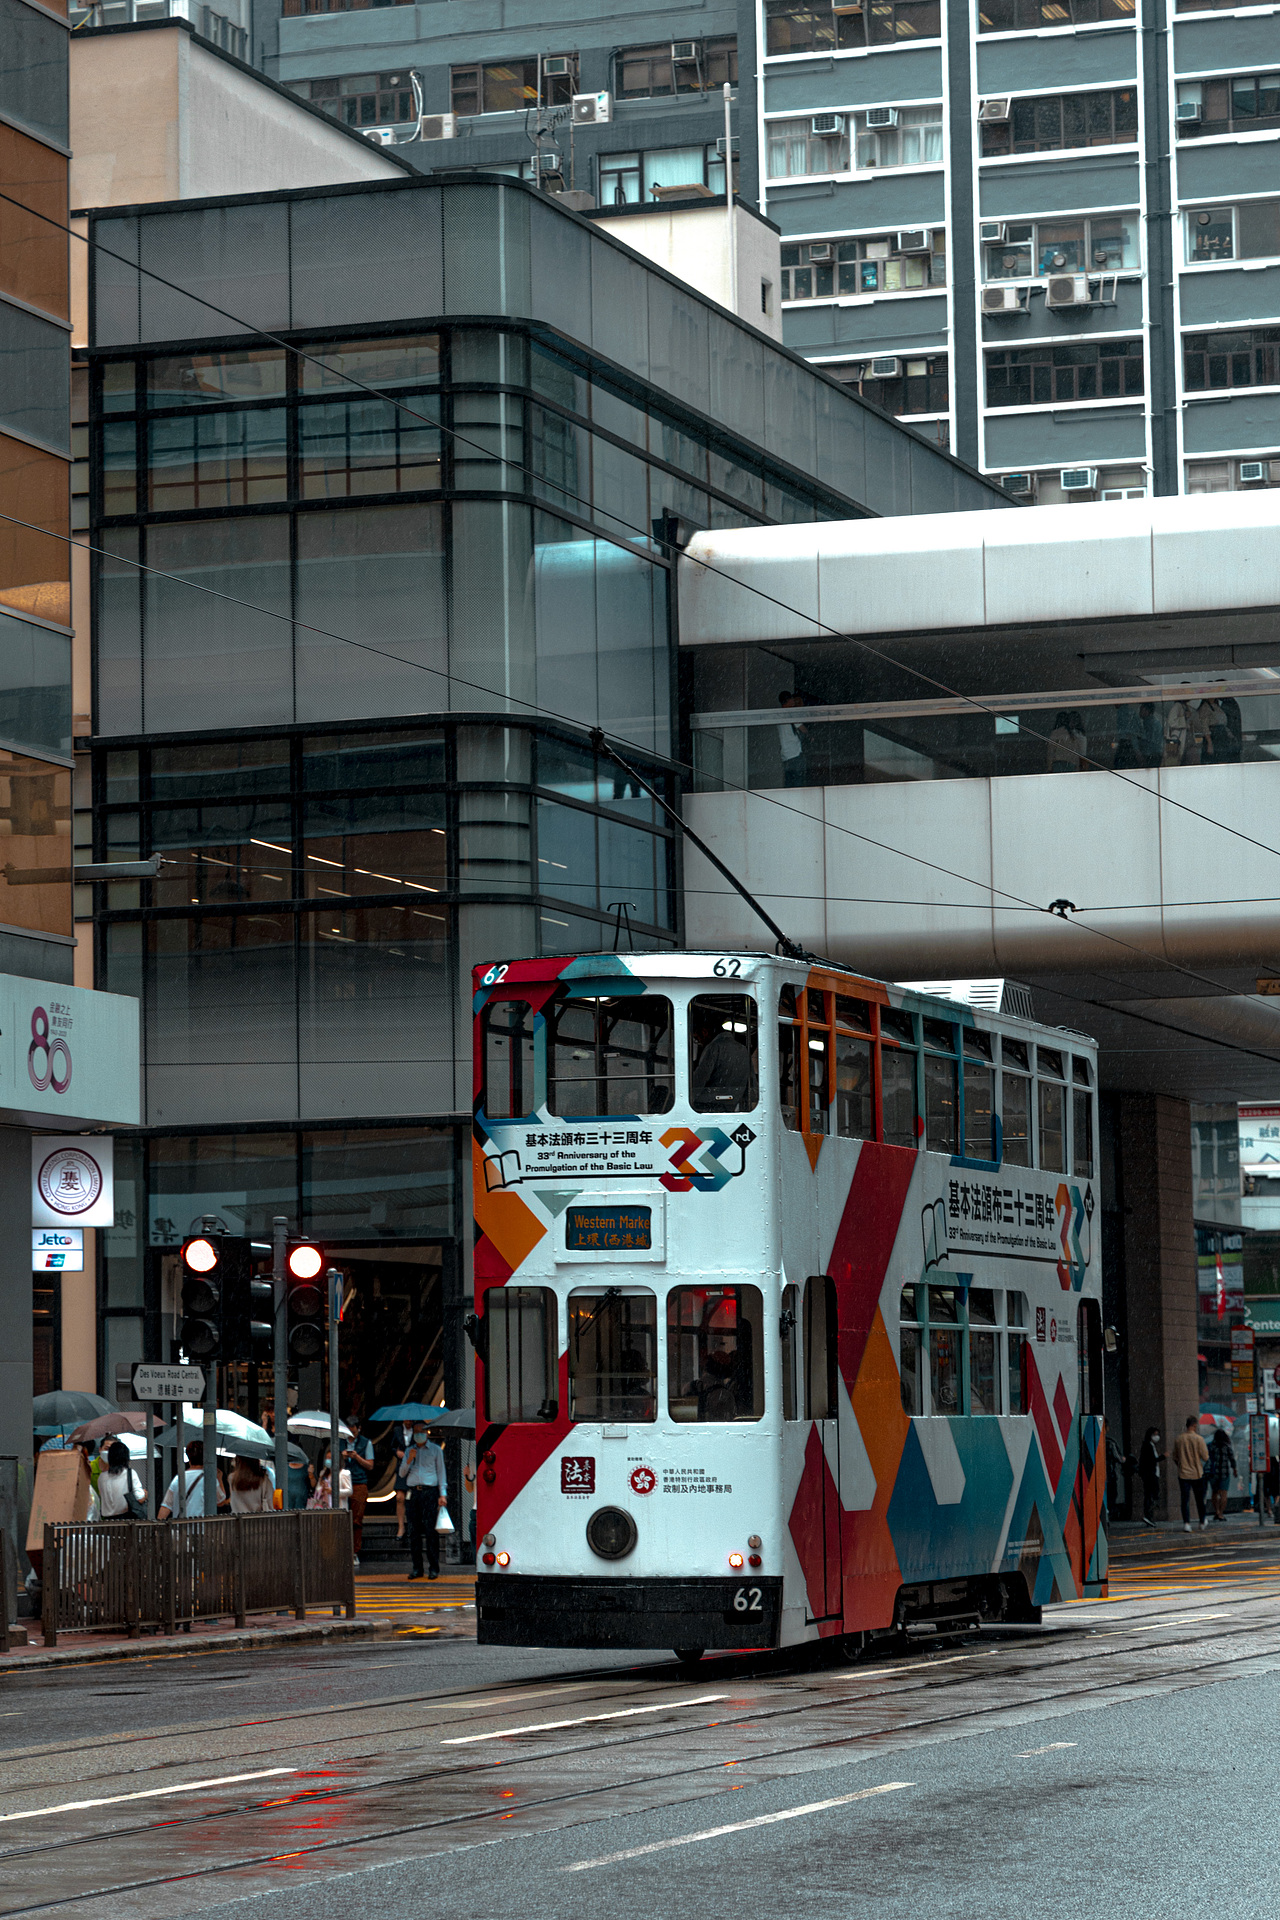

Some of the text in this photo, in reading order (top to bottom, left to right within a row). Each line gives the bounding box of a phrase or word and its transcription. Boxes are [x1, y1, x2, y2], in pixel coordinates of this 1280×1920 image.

[484, 964, 509, 985] 62
[713, 958, 741, 978] 62
[27, 1006, 72, 1094] 80
[525, 1131, 653, 1148] 基本法頒布三十三周年
[735, 1129, 751, 1142] rd
[537, 1150, 636, 1160] 33rd Anniversary of the
[525, 1163, 578, 1173] Promulgation
[590, 1163, 604, 1171] the
[606, 1162, 632, 1170] Basic
[634, 1162, 653, 1170] Law
[54, 1201, 88, 1211] HONG KONG
[948, 1179, 1055, 1231] 基本法頒布三十三周年
[574, 1215, 650, 1229] Western Marke
[959, 1228, 985, 1245] Anniversary
[997, 1232, 1024, 1248] Promulgation
[1036, 1237, 1048, 1250] Basic
[1048, 1239, 1057, 1250] Law
[140, 1369, 199, 1379] Des Voeux Road Central
[733, 1587, 762, 1611] 62
